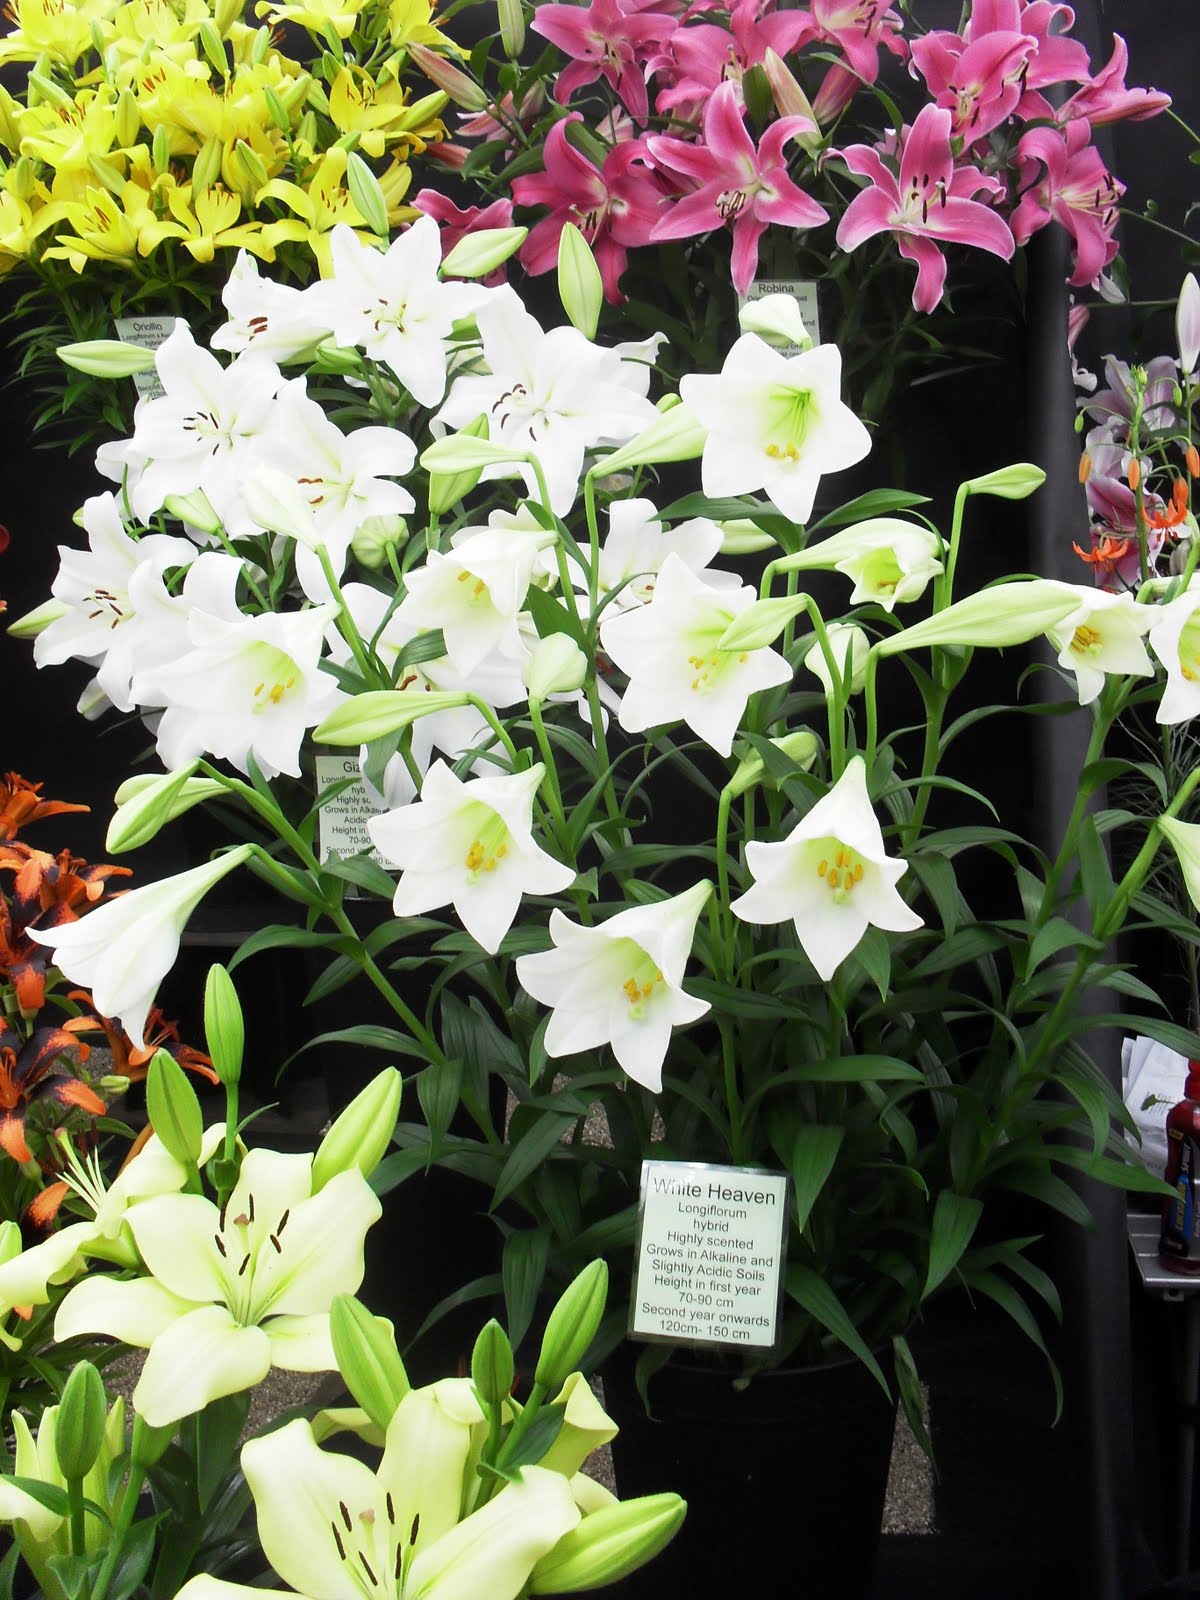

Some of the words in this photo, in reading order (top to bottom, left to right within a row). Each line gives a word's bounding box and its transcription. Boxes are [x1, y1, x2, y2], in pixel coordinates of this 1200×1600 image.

[758, 283, 795, 293] Robina
[343, 761, 361, 773] Giz
[351, 786, 366, 795] hyb
[336, 796, 360, 805] Highly
[324, 805, 349, 814] Grows
[351, 805, 358, 814] in
[343, 816, 367, 824] Acidic
[331, 826, 357, 835] Height
[358, 825, 366, 834] in
[349, 836, 371, 844] 70-90
[653, 1177, 702, 1197] White
[708, 1183, 776, 1205] Heaven
[678, 1202, 747, 1219] Longiflorum
[693, 1218, 729, 1232] hybrid
[667, 1231, 704, 1247] Highly
[706, 1236, 754, 1250] scented
[646, 1243, 684, 1258] Grows
[687, 1248, 697, 1259] in
[700, 1250, 747, 1265] Alkaline
[750, 1256, 773, 1267] and
[652, 1259, 694, 1275] Slightly
[696, 1265, 733, 1278] Acidic
[736, 1268, 765, 1281] Soils
[654, 1275, 692, 1289] Height
[695, 1279, 706, 1290] in
[709, 1281, 732, 1293] first
[734, 1285, 761, 1297] year
[679, 1292, 712, 1306] 70-90
[716, 1297, 734, 1308] cm
[642, 1302, 686, 1318] Second
[689, 1309, 716, 1321] year
[719, 1313, 770, 1327] onwards
[659, 1320, 703, 1335] 120cm-
[707, 1325, 729, 1338] 150
[732, 1329, 750, 1340] cm
